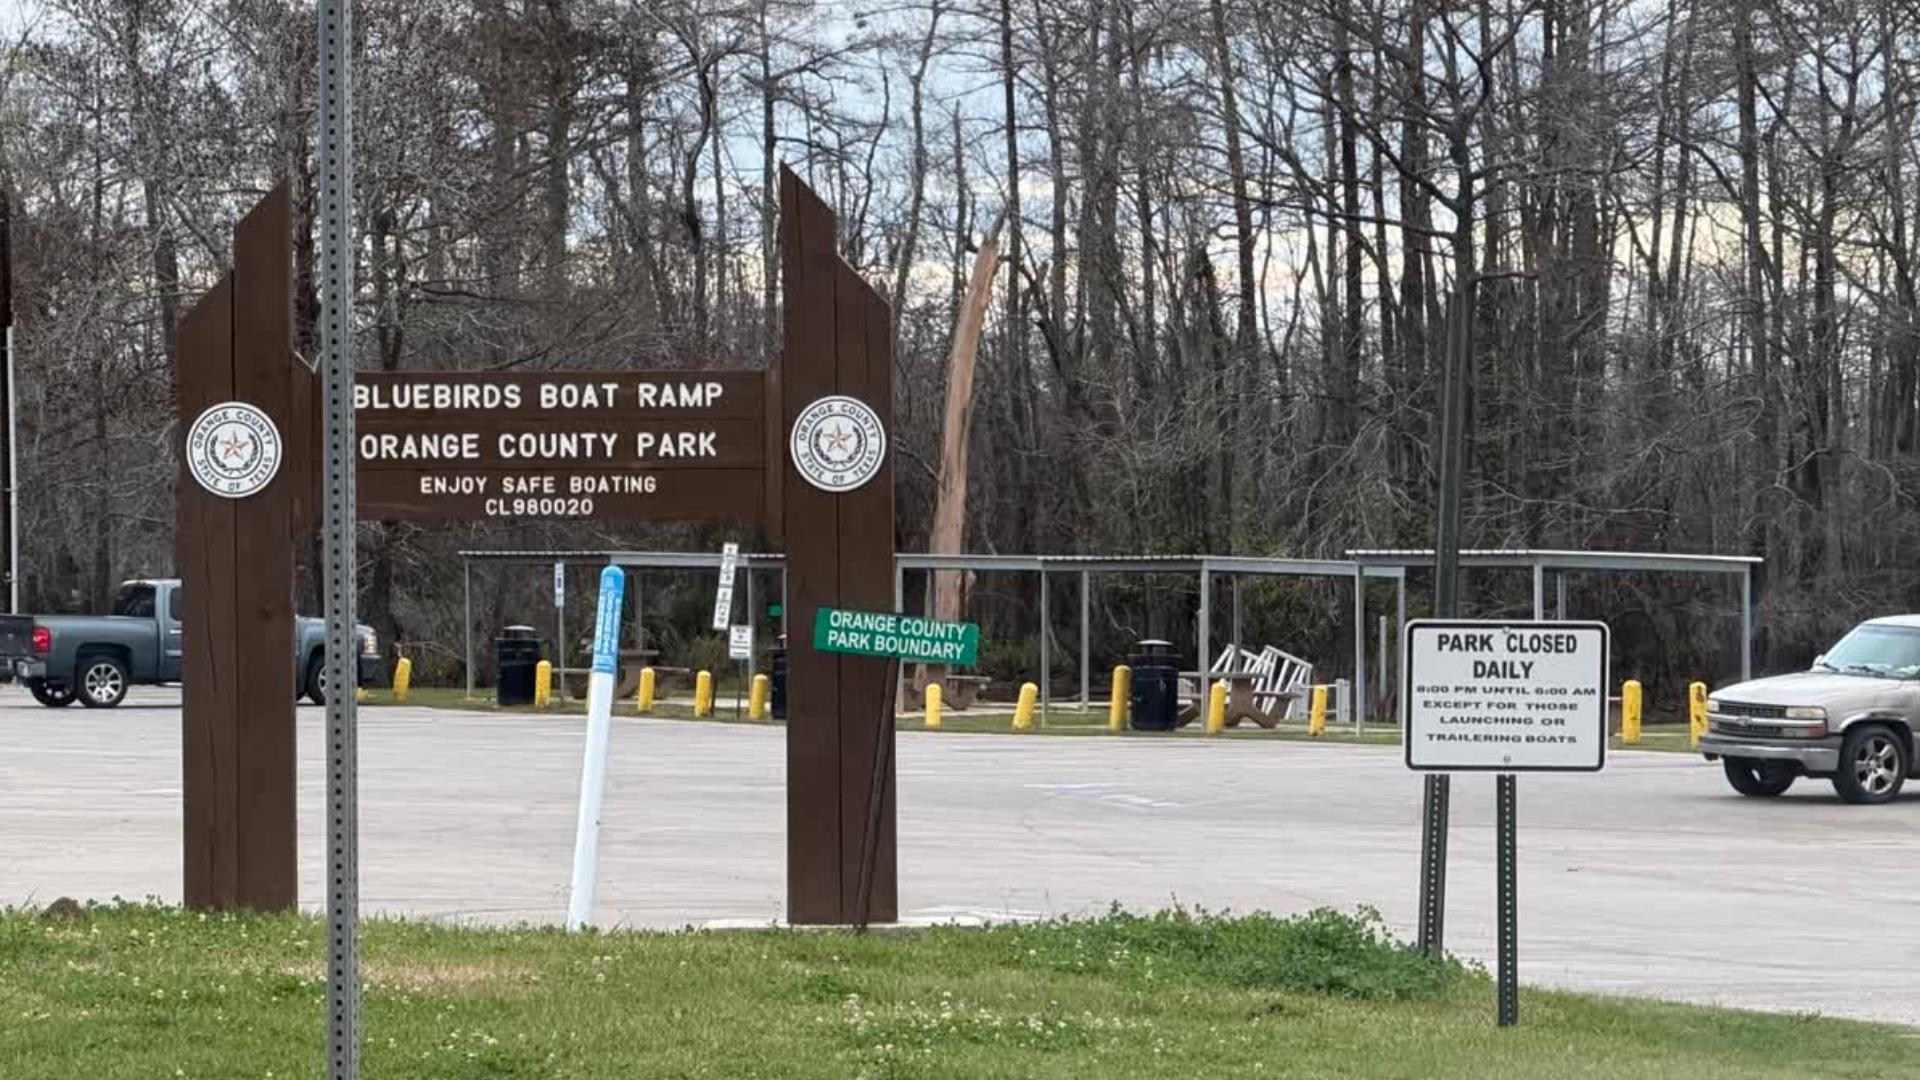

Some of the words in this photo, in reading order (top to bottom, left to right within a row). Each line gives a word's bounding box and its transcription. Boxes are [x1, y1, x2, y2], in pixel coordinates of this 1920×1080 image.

[354, 383, 522, 409] BLUEBIRDS
[540, 382, 619, 409] BOAT
[638, 382, 724, 408] RAMP
[194, 410, 230, 449] ORANGE
[236, 410, 273, 445] COUNTY
[798, 404, 834, 441] ORANGE
[841, 404, 877, 438] COUNTY
[360, 433, 481, 460] ORANGE
[497, 432, 618, 459] COUNTY
[637, 431, 718, 458] PARK
[197, 459, 221, 487] STATE
[228, 482, 241, 491] OF
[249, 456, 273, 486] TEXAS
[801, 451, 825, 479] STATE
[832, 475, 845, 485] OF
[853, 449, 877, 478] TEXAS
[420, 476, 488, 494] ENJOY
[502, 476, 556, 494] SAFE
[569, 476, 657, 494] BOATING
[485, 498, 594, 516] CL980020
[829, 611, 897, 633] ORANGE
[900, 619, 967, 641] COUNTY
[827, 630, 871, 650] PARK
[874, 635, 966, 660] BOUNDARY
[1437, 633, 1494, 653] PARK
[1506, 633, 1578, 654] CLOSED
[1473, 660, 1535, 680] DAILY
[1454, 685, 1478, 694] PM
[1482, 685, 1531, 696] UNTIL
[1572, 687, 1596, 696] AM
[1423, 700, 1482, 709] EXCEPT
[1487, 701, 1518, 710] FOR
[1525, 702, 1579, 711] THOSE
[1440, 716, 1534, 725] LAUNCHING
[1540, 717, 1566, 726] OR
[1426, 733, 1522, 743] TRAILERING
[1525, 734, 1578, 744] BOATS
